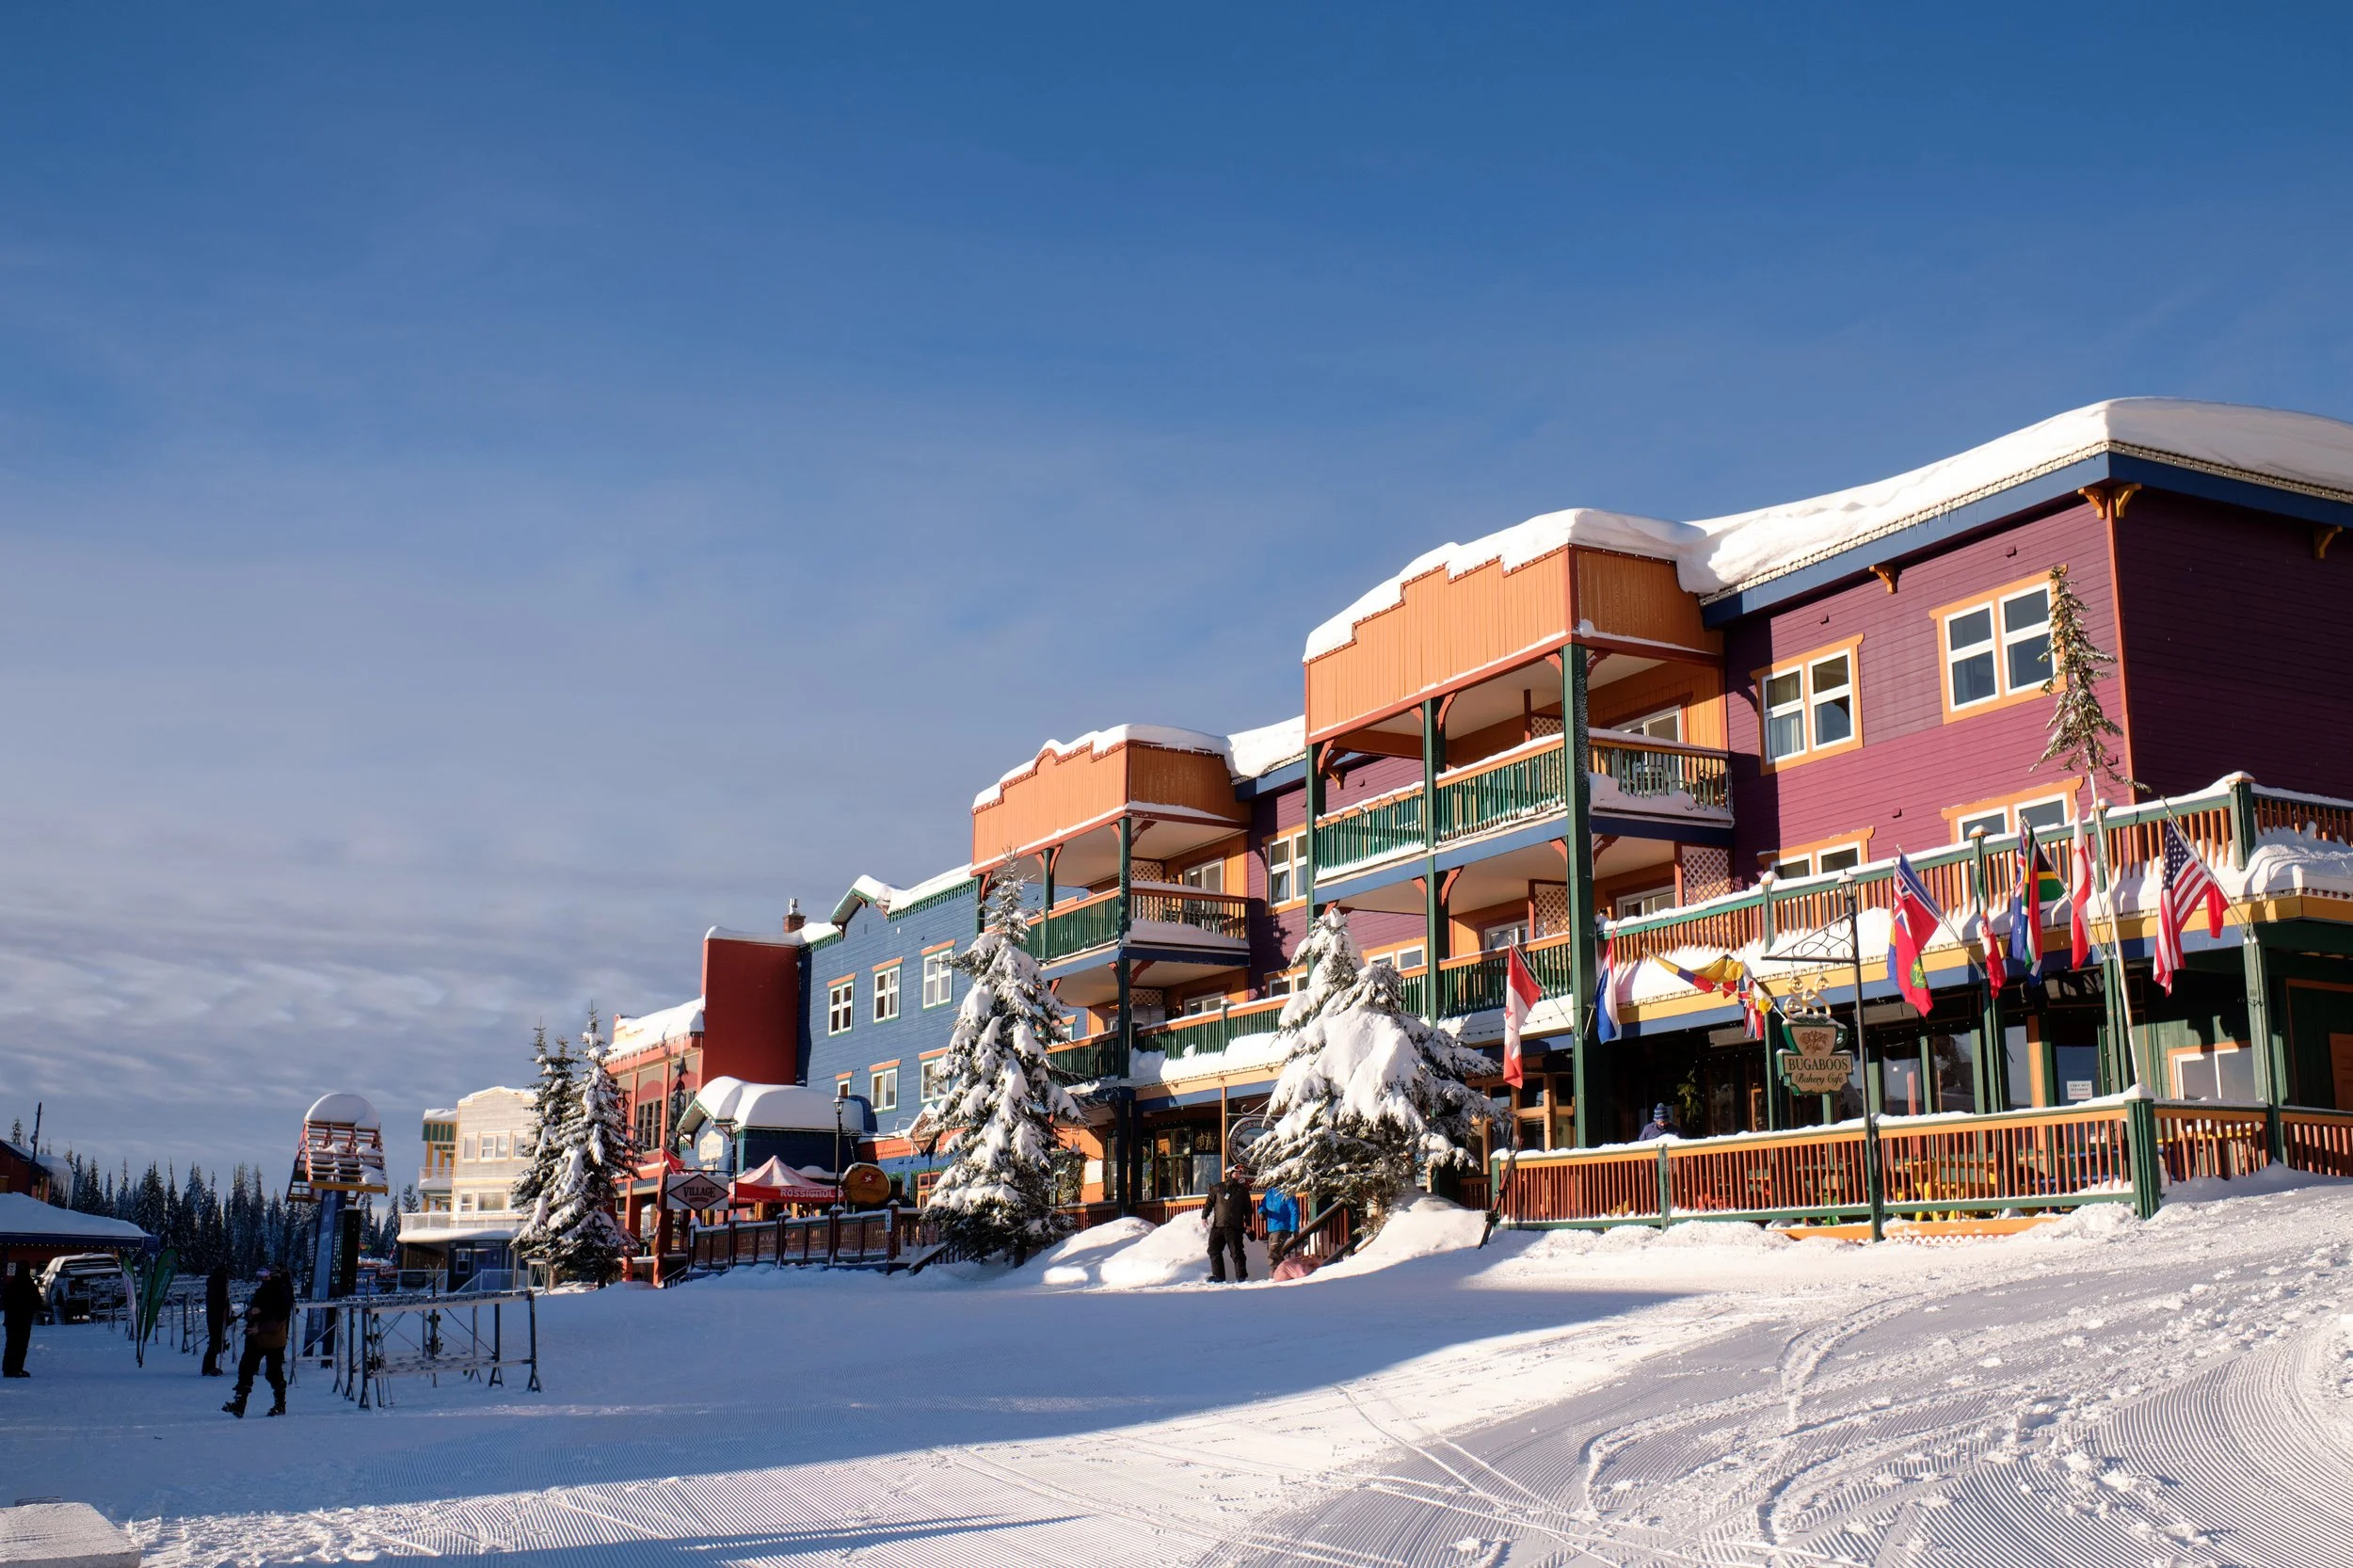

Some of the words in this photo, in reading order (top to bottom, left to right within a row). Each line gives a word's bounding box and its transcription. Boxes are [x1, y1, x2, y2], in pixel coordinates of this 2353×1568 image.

[1788, 1058, 1849, 1070] BUGABOOS
[1796, 1073, 1824, 1085] Bakery
[683, 1187, 716, 1198] VILLAGE
[780, 1189, 836, 1197] ROSSIGNOL
